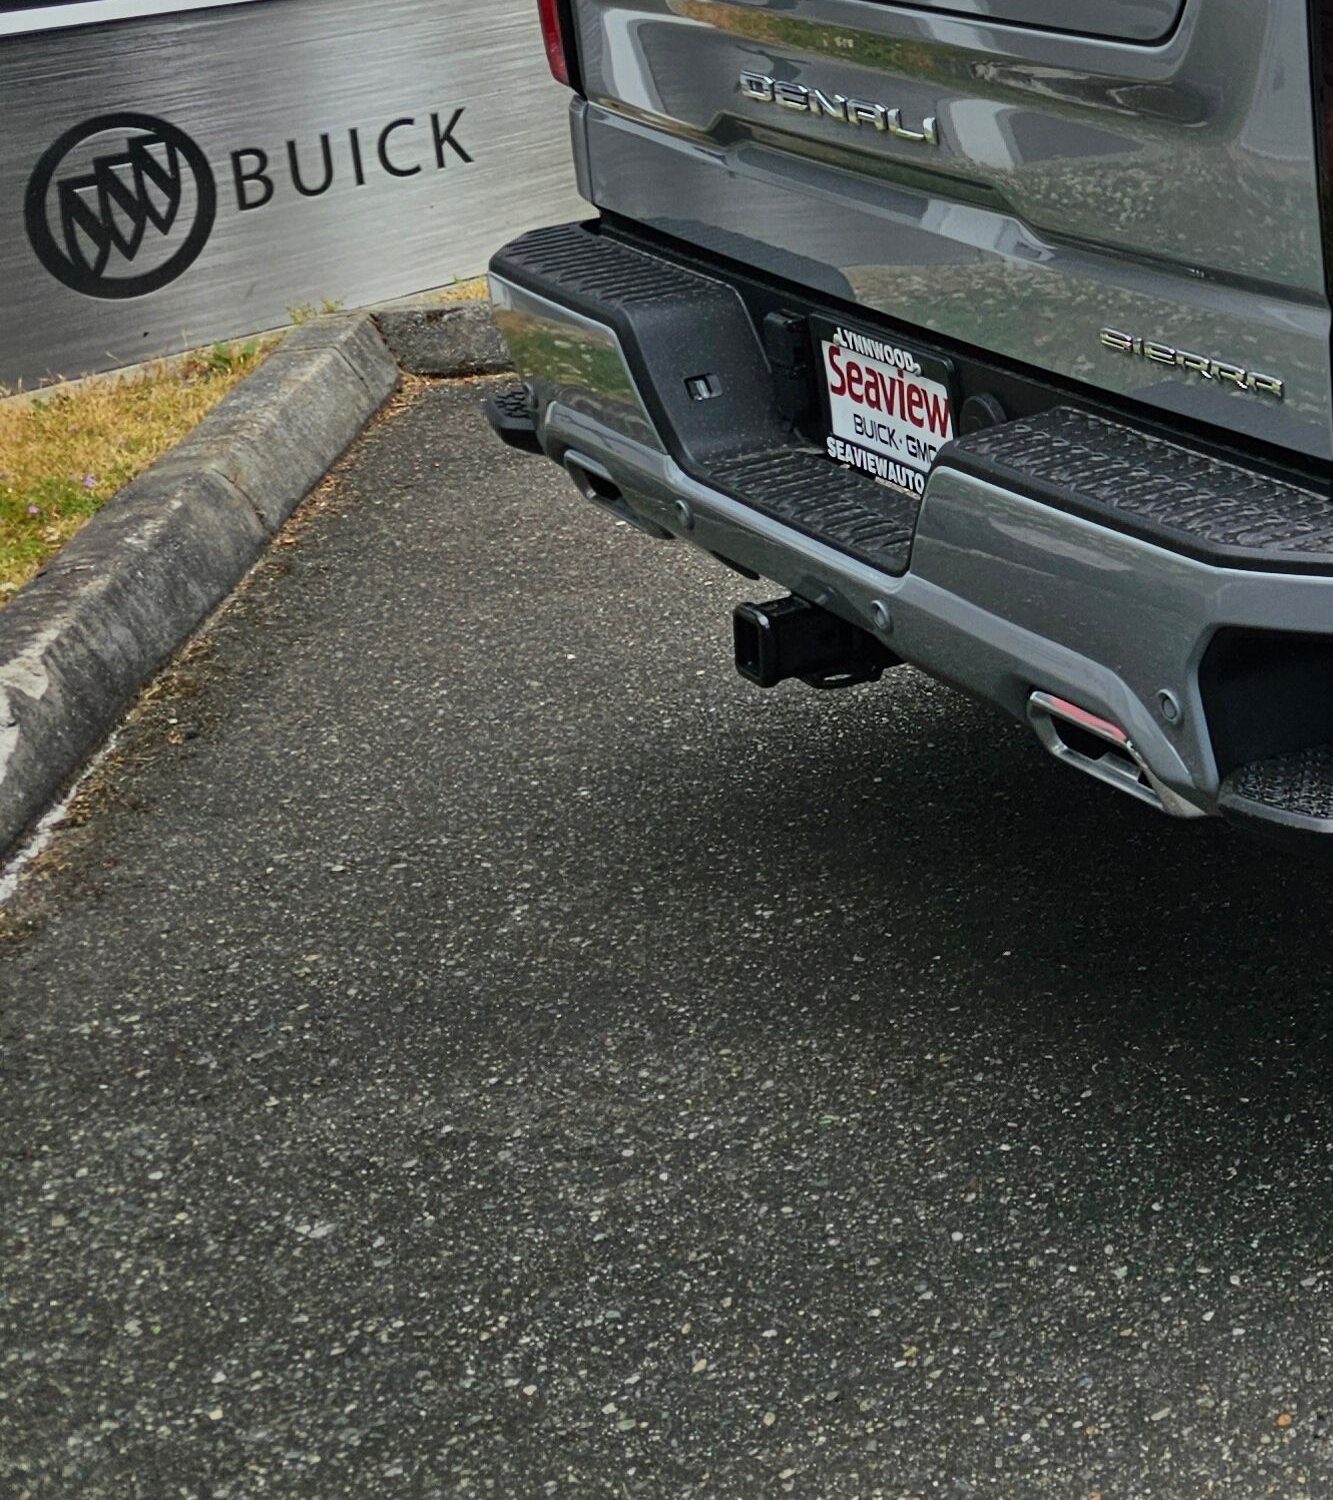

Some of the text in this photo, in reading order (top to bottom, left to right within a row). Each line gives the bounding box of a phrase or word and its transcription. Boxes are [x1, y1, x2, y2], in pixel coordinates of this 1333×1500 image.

[739, 69, 940, 145] DENALI
[231, 106, 475, 211] BUICK
[836, 327, 915, 373] LYNNWOOD
[1101, 327, 1284, 399] SIERRA
[828, 345, 950, 438] Seaview
[826, 436, 926, 494] SEAVIEWAUTO
[853, 413, 900, 451] BUICK
